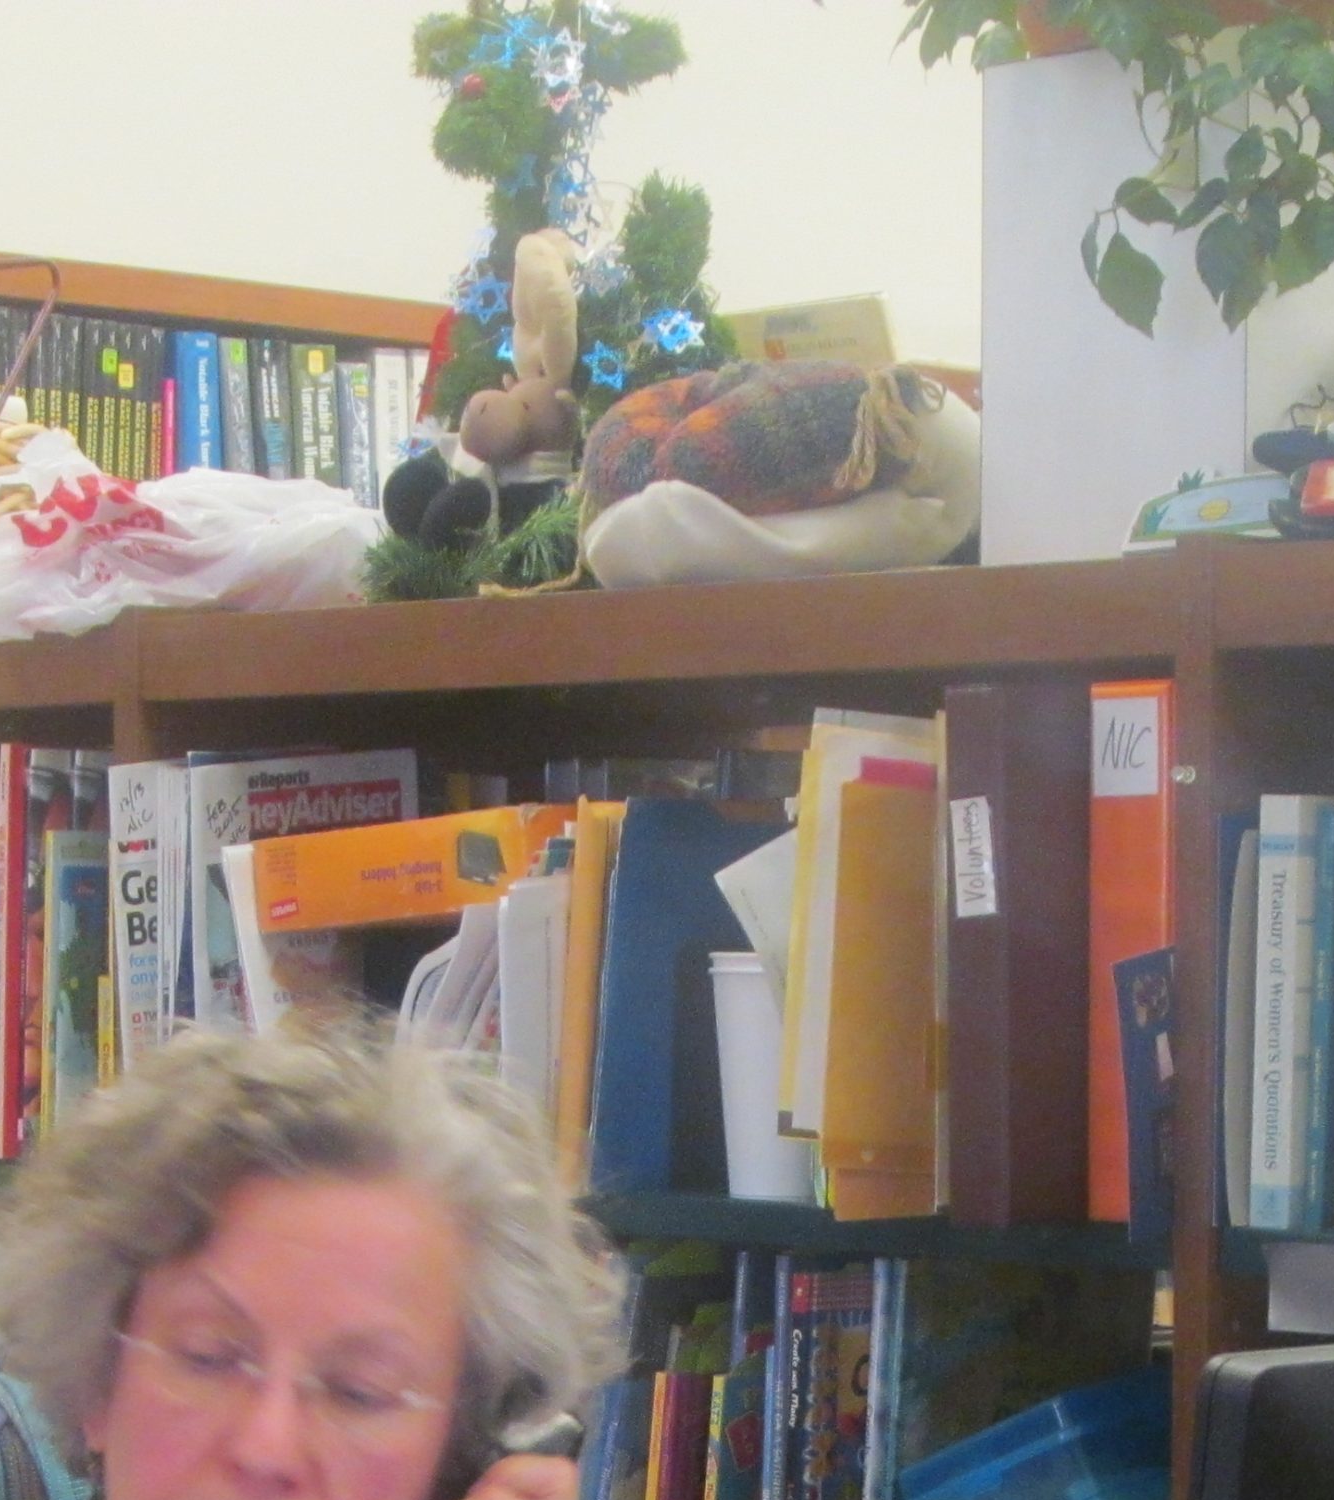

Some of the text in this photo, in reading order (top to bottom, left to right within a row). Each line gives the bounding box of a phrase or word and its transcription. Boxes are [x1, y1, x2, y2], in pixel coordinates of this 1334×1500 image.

[200, 405, 211, 437] Black
[320, 435, 334, 468] Black
[1101, 716, 1151, 770] NIC
[959, 800, 987, 903] Volunteers
[1263, 870, 1286, 1171] Treasury of Women's Quotations
[791, 1328, 803, 1368] Create
